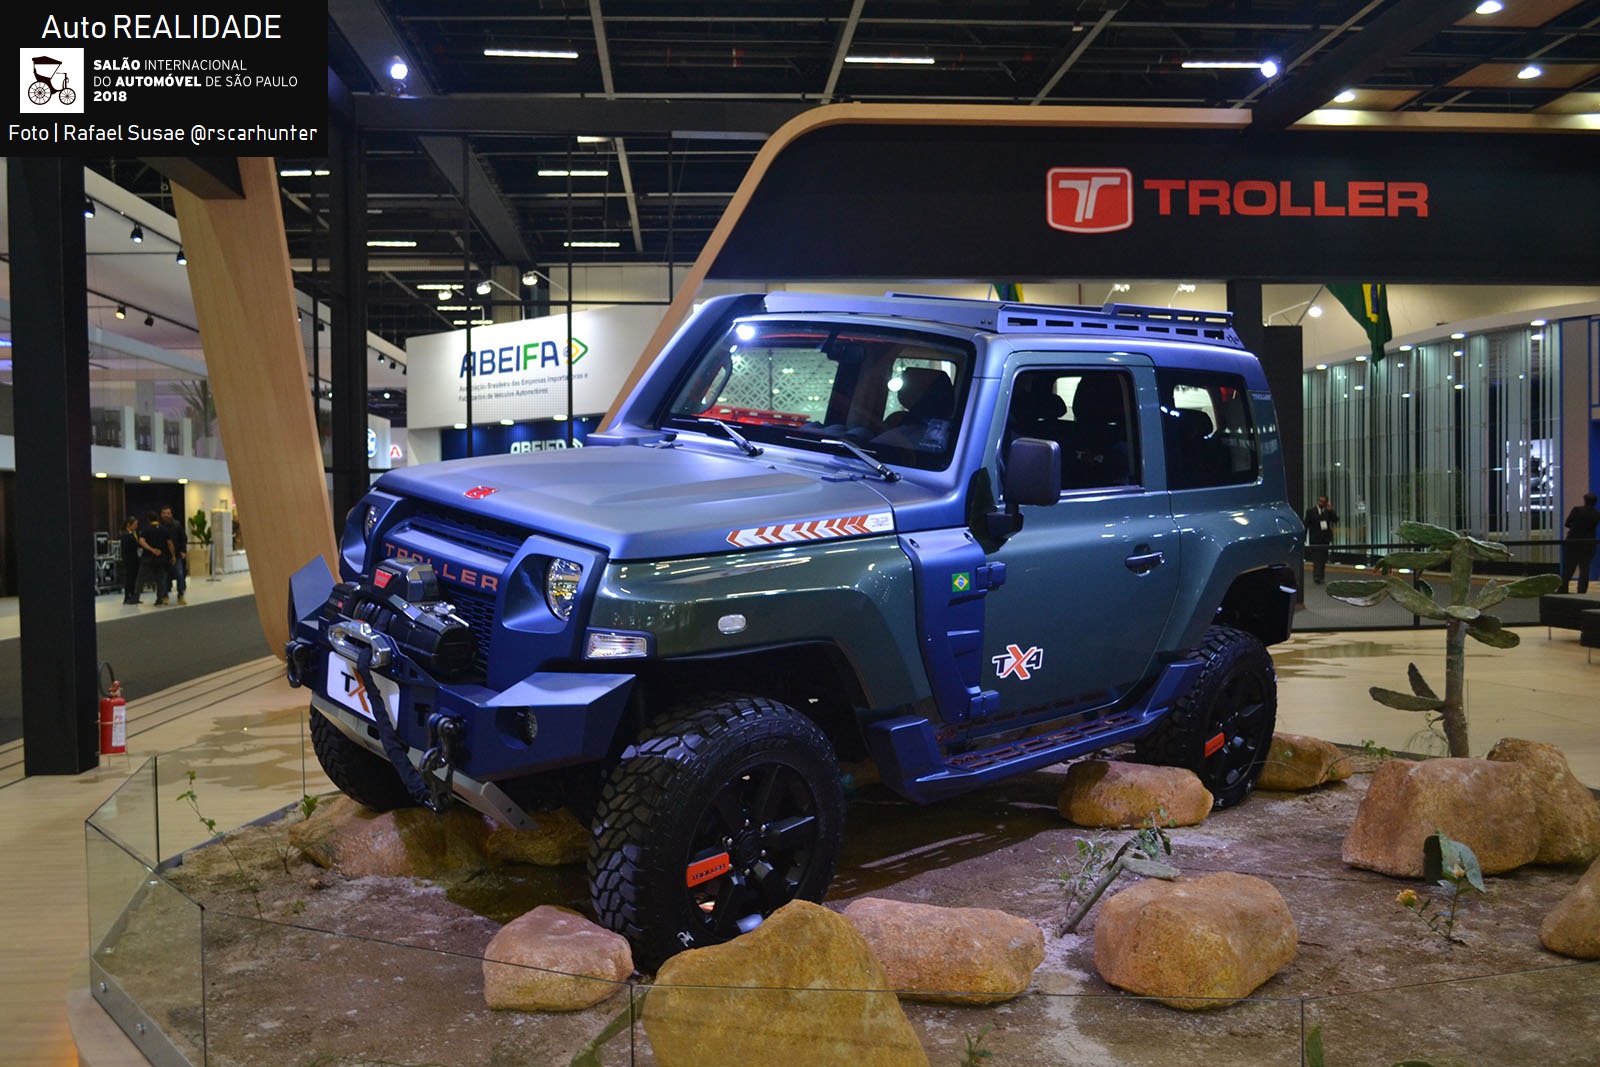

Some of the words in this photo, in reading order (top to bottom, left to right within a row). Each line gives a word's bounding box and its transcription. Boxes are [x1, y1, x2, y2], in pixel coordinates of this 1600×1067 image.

[1143, 179, 1429, 217] TROLLER
[459, 340, 560, 378] ABEIFA
[548, 374, 583, 384] Importaoras
[992, 644, 1043, 680] TX4
